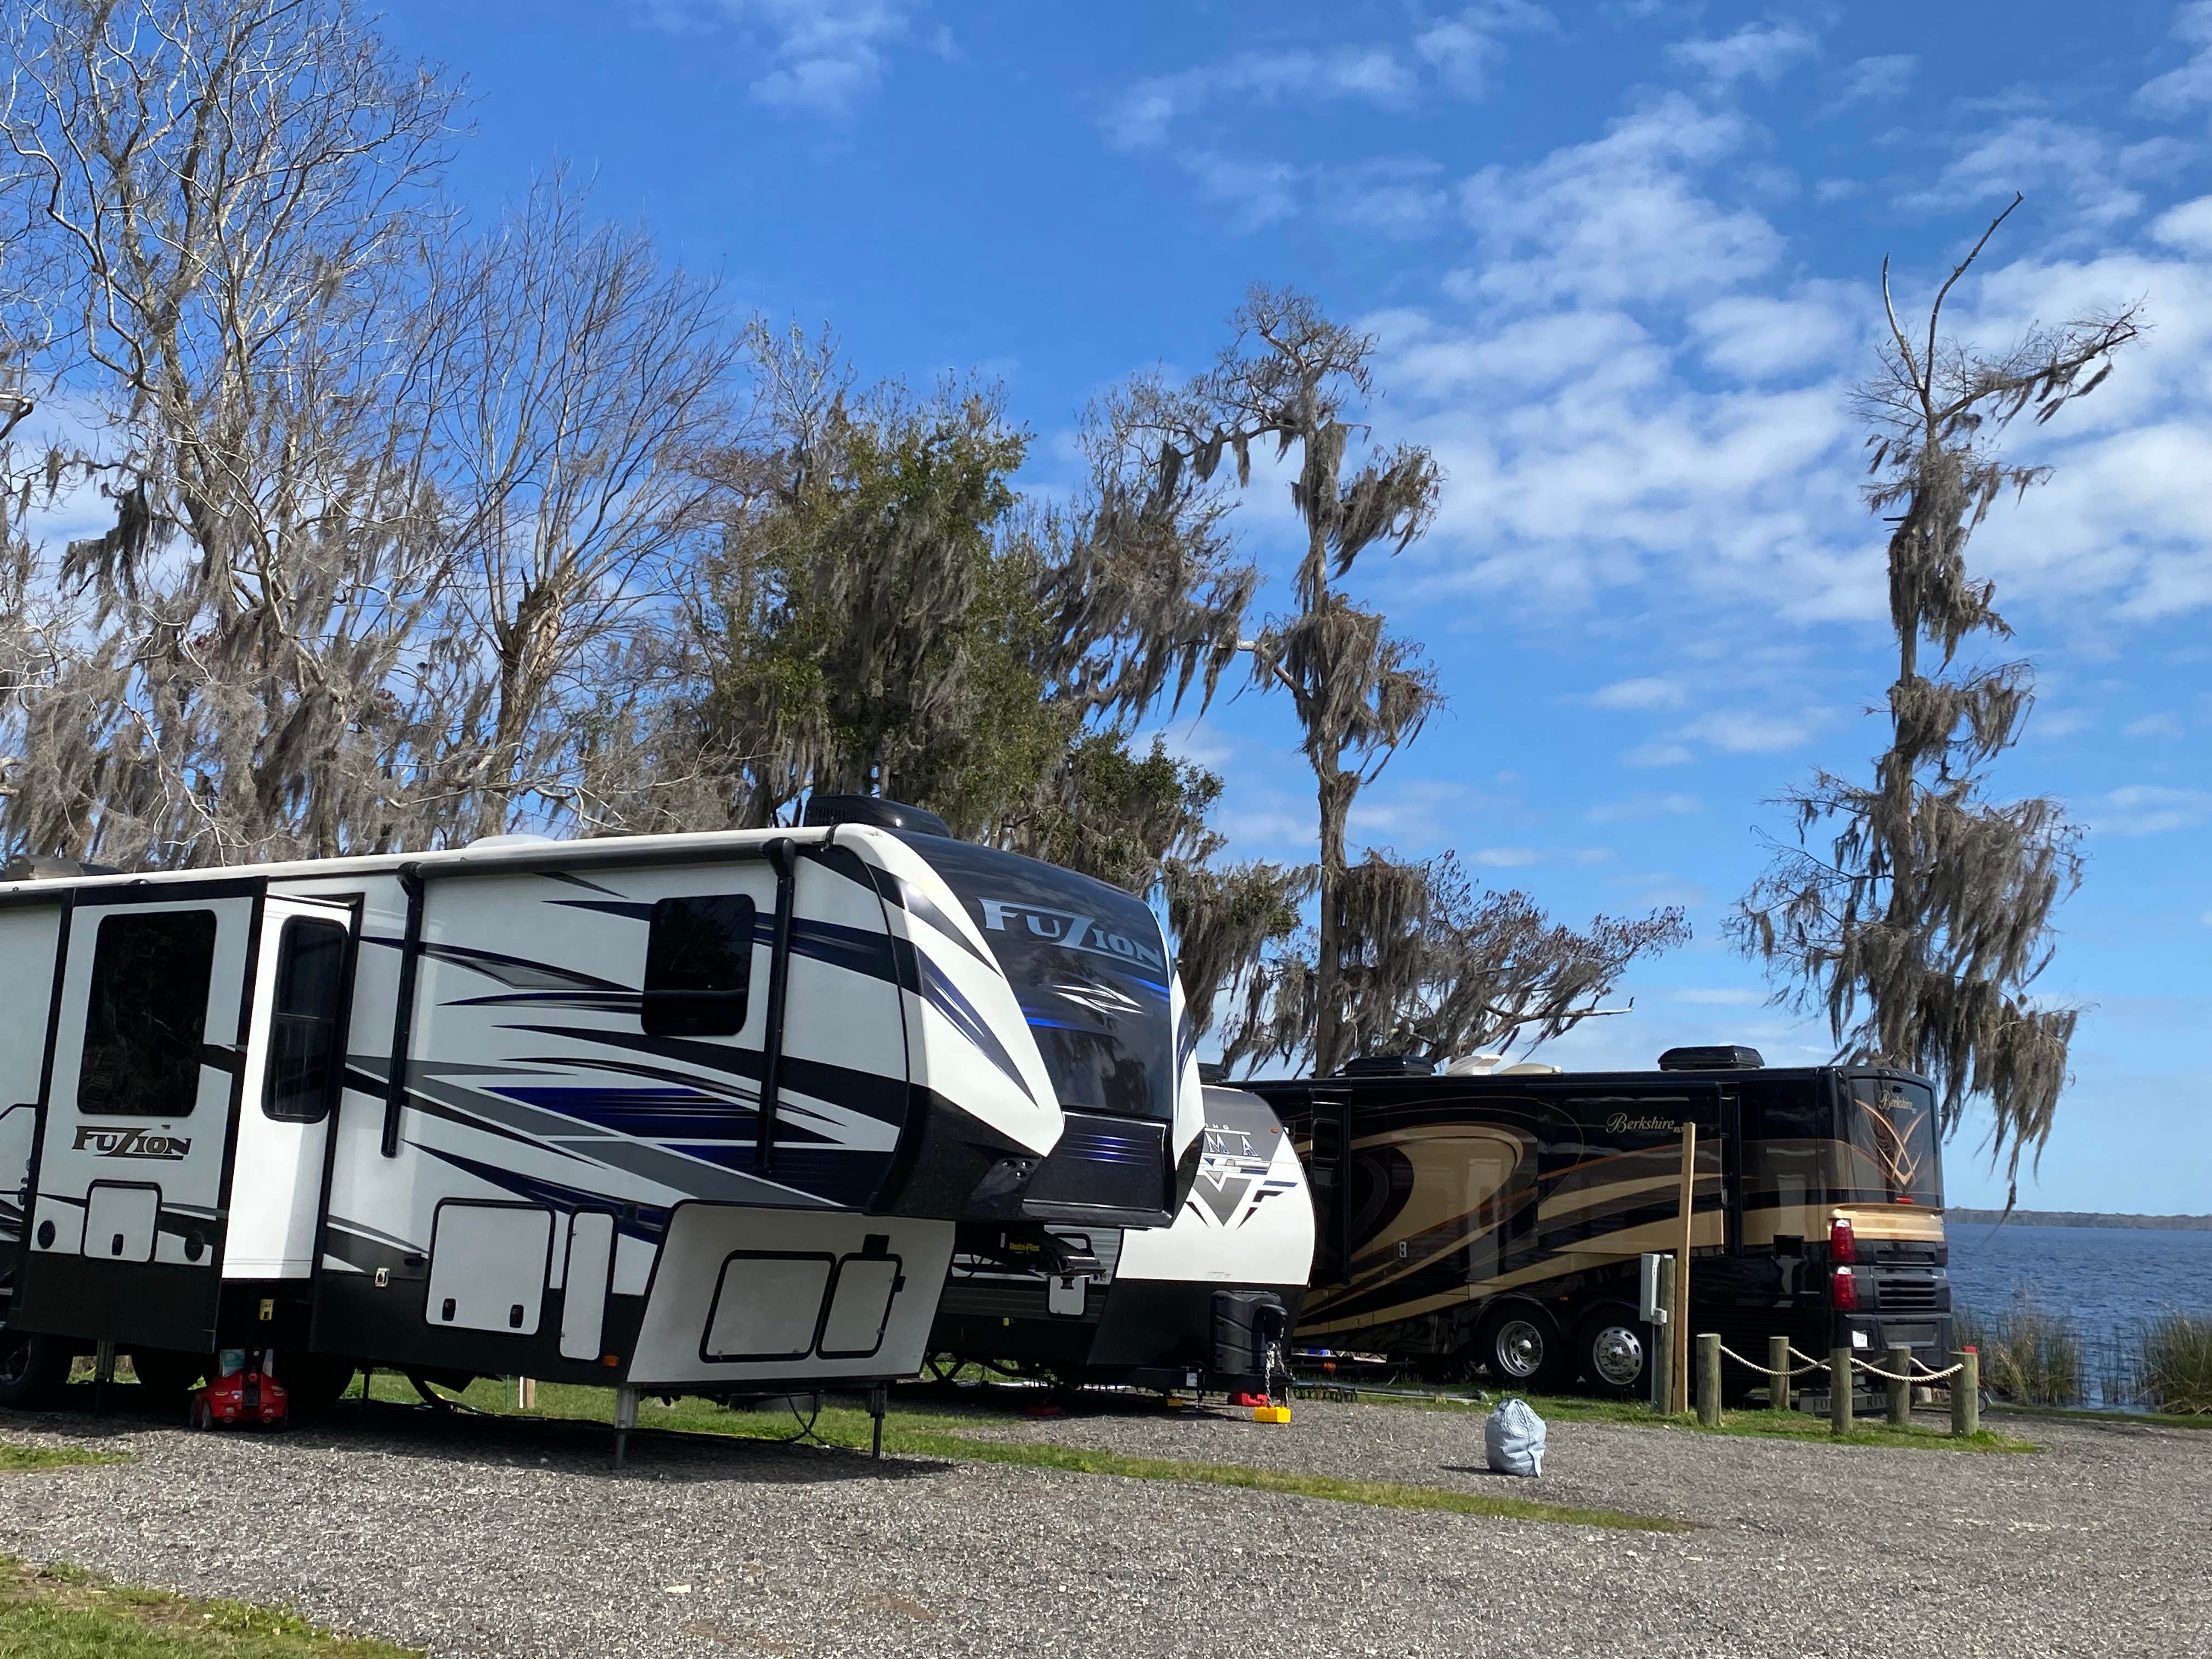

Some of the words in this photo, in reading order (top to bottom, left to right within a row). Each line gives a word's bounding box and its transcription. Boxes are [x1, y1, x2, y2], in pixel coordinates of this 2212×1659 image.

[977, 896, 1165, 974] FUZION
[1606, 1112, 1674, 1133] Berkshire
[71, 1125, 192, 1161] FUZION
[1205, 1131, 1260, 1156] MA
